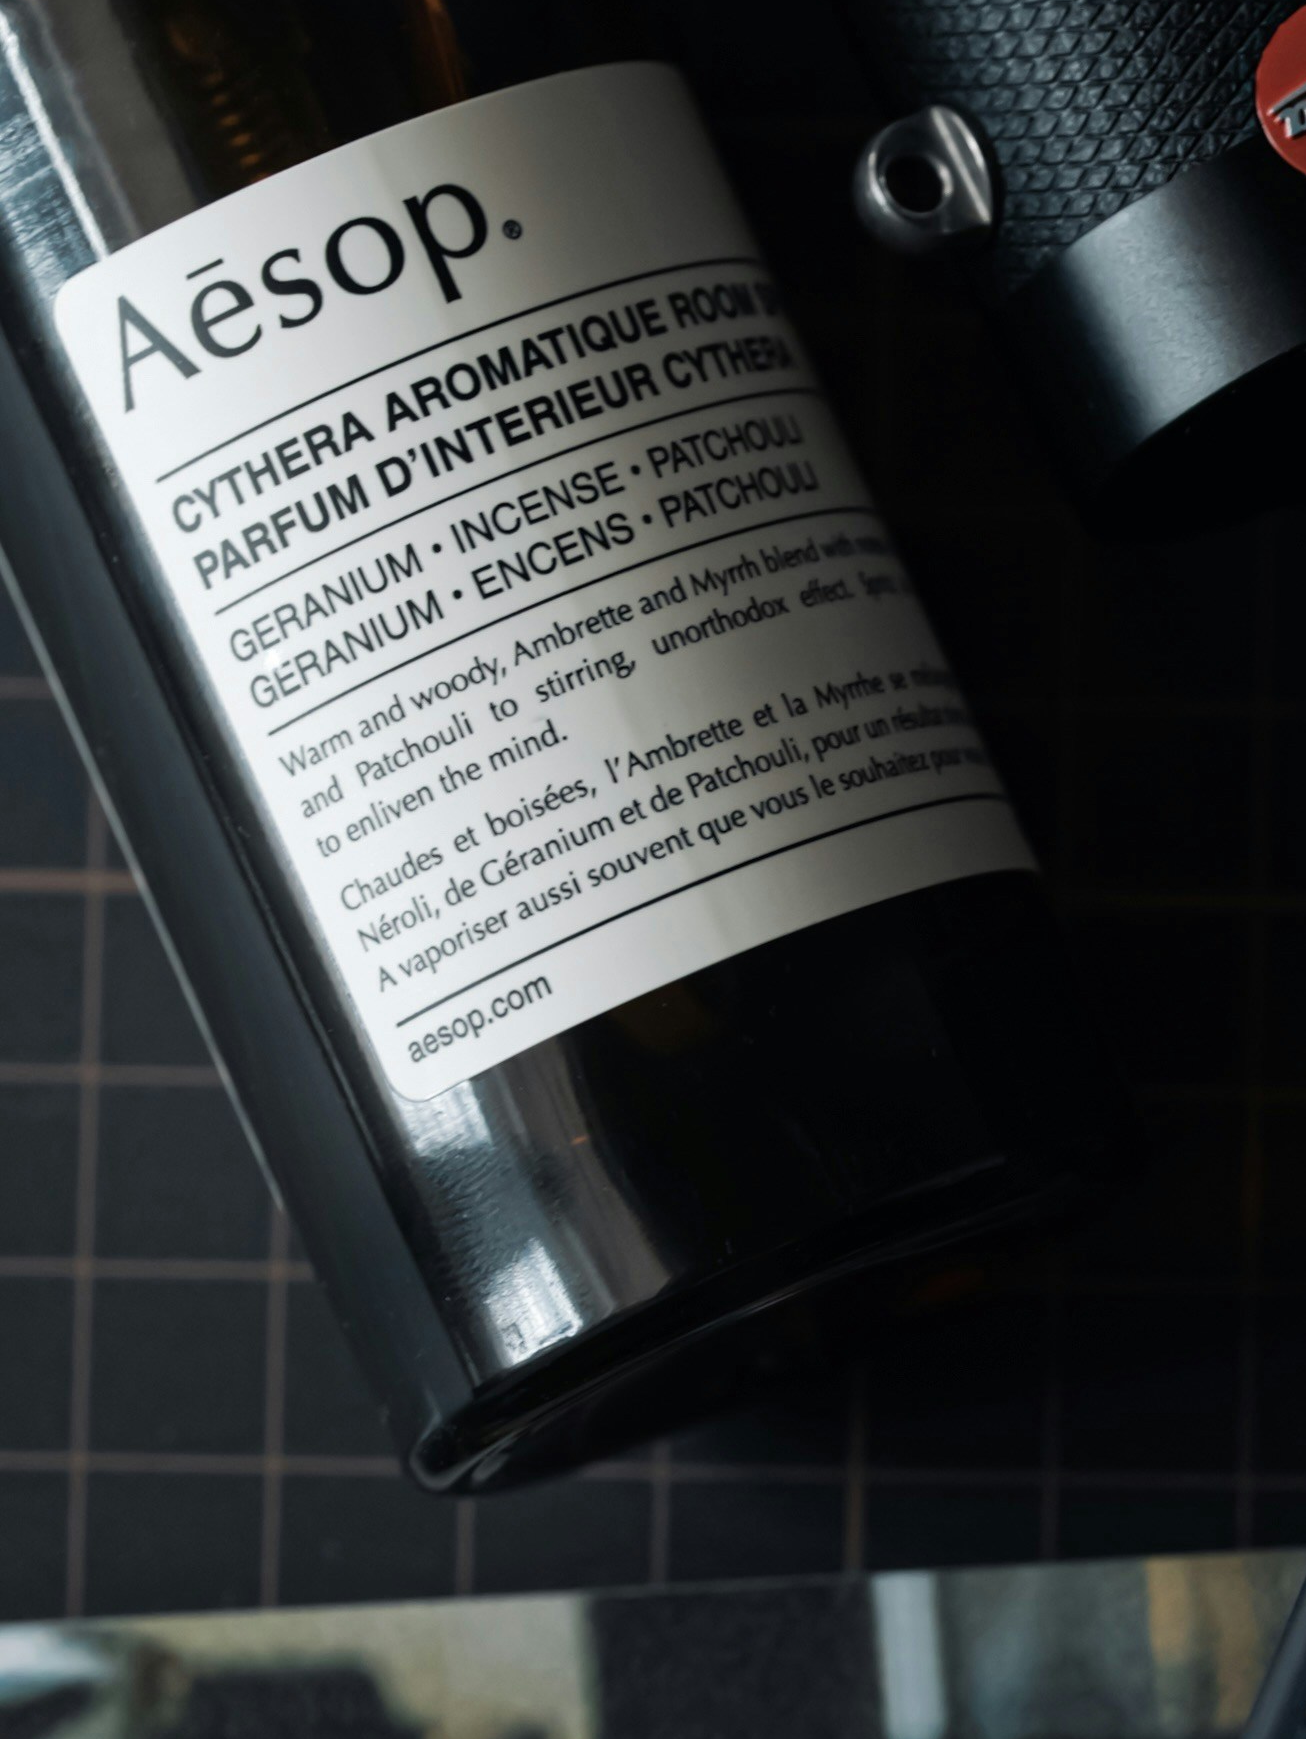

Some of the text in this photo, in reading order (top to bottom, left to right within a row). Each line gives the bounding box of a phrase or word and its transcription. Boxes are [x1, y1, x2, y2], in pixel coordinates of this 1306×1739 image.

[172, 282, 754, 534] CYTHERA AROMATIQUE ROOM
[193, 474, 370, 590] PARFUM
[375, 363, 660, 498] D'INTERIEUR
[230, 542, 424, 662] GERANIUM
[451, 462, 626, 554] INCENSE
[278, 729, 354, 777] Warm
[358, 694, 406, 738] and
[410, 656, 507, 710] woody,
[513, 599, 635, 666] Ambrette
[640, 576, 688, 615] and
[689, 554, 762, 598] Myrrh
[763, 538, 819, 575] blend
[471, 512, 635, 600] ENCENS
[301, 774, 344, 818] and
[355, 711, 474, 787] Patchouli
[489, 697, 519, 723] to
[534, 650, 636, 704] stirring,
[651, 596, 790, 656] unorthodox
[316, 718, 569, 858] to enliven the mind.
[340, 846, 444, 911] Chaudes
[453, 827, 481, 853] et
[485, 778, 597, 837] boisées,
[752, 704, 778, 729] et
[781, 692, 809, 719] la
[814, 671, 886, 711] Myrrhe
[357, 894, 441, 953] Néroli,
[444, 877, 477, 907] de
[480, 816, 615, 886] Géranium
[619, 799, 647, 825] et
[650, 784, 685, 814] de
[686, 736, 810, 799] Patchouli,
[811, 723, 861, 764] pour
[865, 716, 892, 740] un
[377, 965, 398, 993] A
[398, 908, 509, 975] vaporiser
[517, 871, 582, 920] aussi
[587, 823, 695, 888] souvent
[697, 807, 748, 846] que
[750, 786, 809, 820] vous
[809, 773, 836, 799] le
[839, 751, 930, 792] souhaitez
[407, 975, 553, 1063] aesop.com
